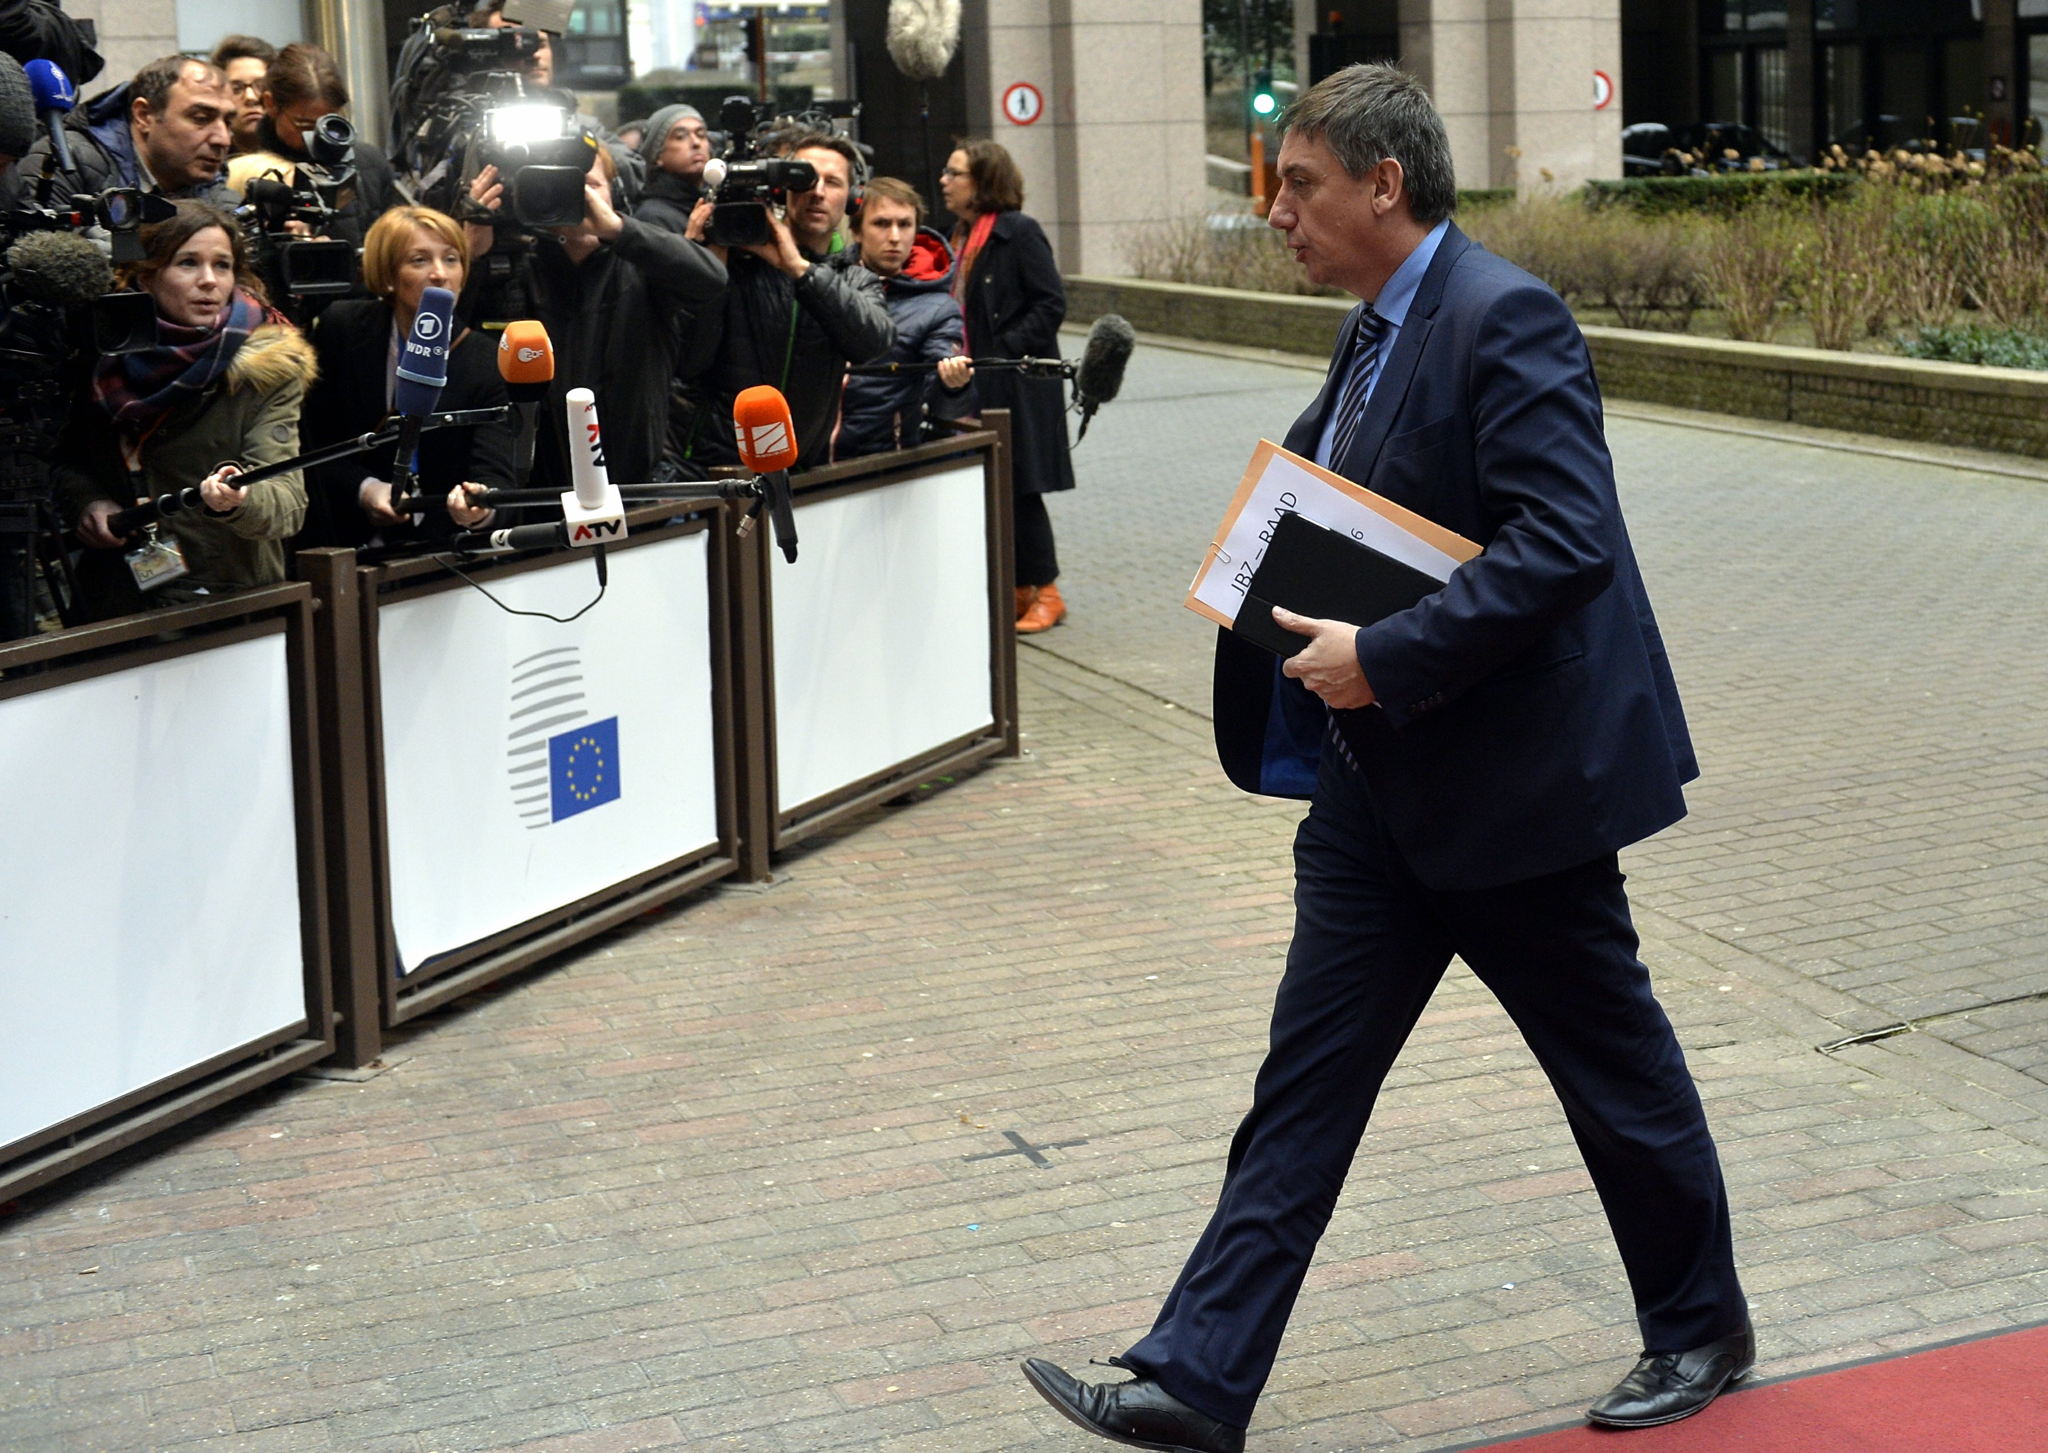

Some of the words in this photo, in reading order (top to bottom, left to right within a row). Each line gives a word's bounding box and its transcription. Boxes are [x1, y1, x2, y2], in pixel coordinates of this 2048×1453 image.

[407, 341, 432, 357] WDR
[574, 519, 621, 541] ATV
[1231, 561, 1254, 596] JBZ
[1259, 492, 1297, 543] RAAD
